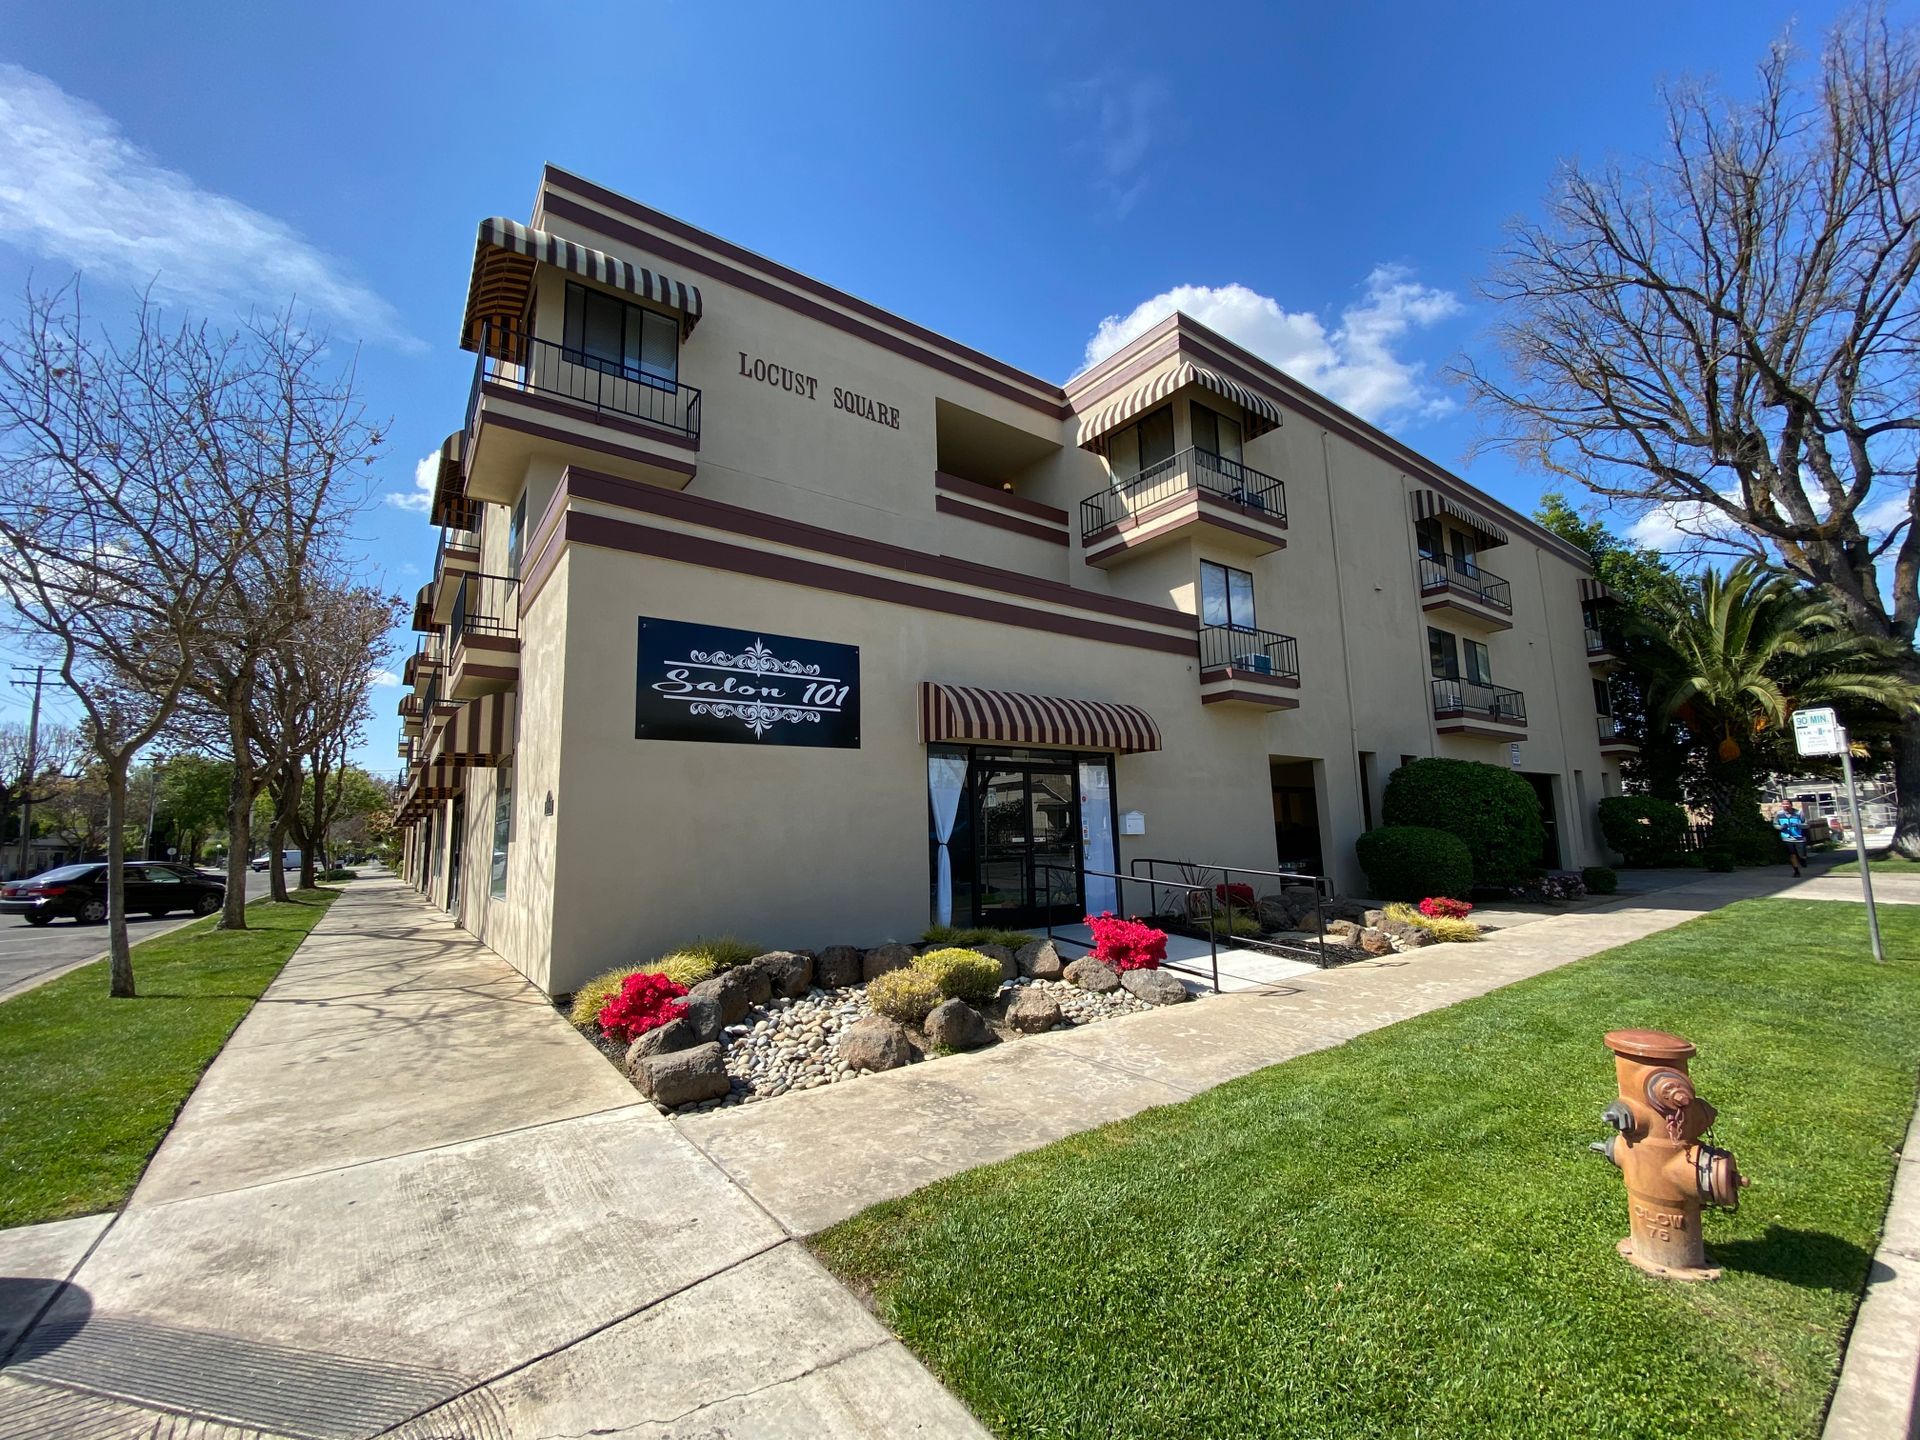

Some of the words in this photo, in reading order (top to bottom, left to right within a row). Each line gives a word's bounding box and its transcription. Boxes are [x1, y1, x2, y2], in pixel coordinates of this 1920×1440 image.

[738, 351, 818, 400] LOCUST
[833, 387, 900, 430] SQUARE
[651, 669, 786, 698] Salon
[801, 682, 850, 706] 101
[1796, 717, 1808, 725] 90
